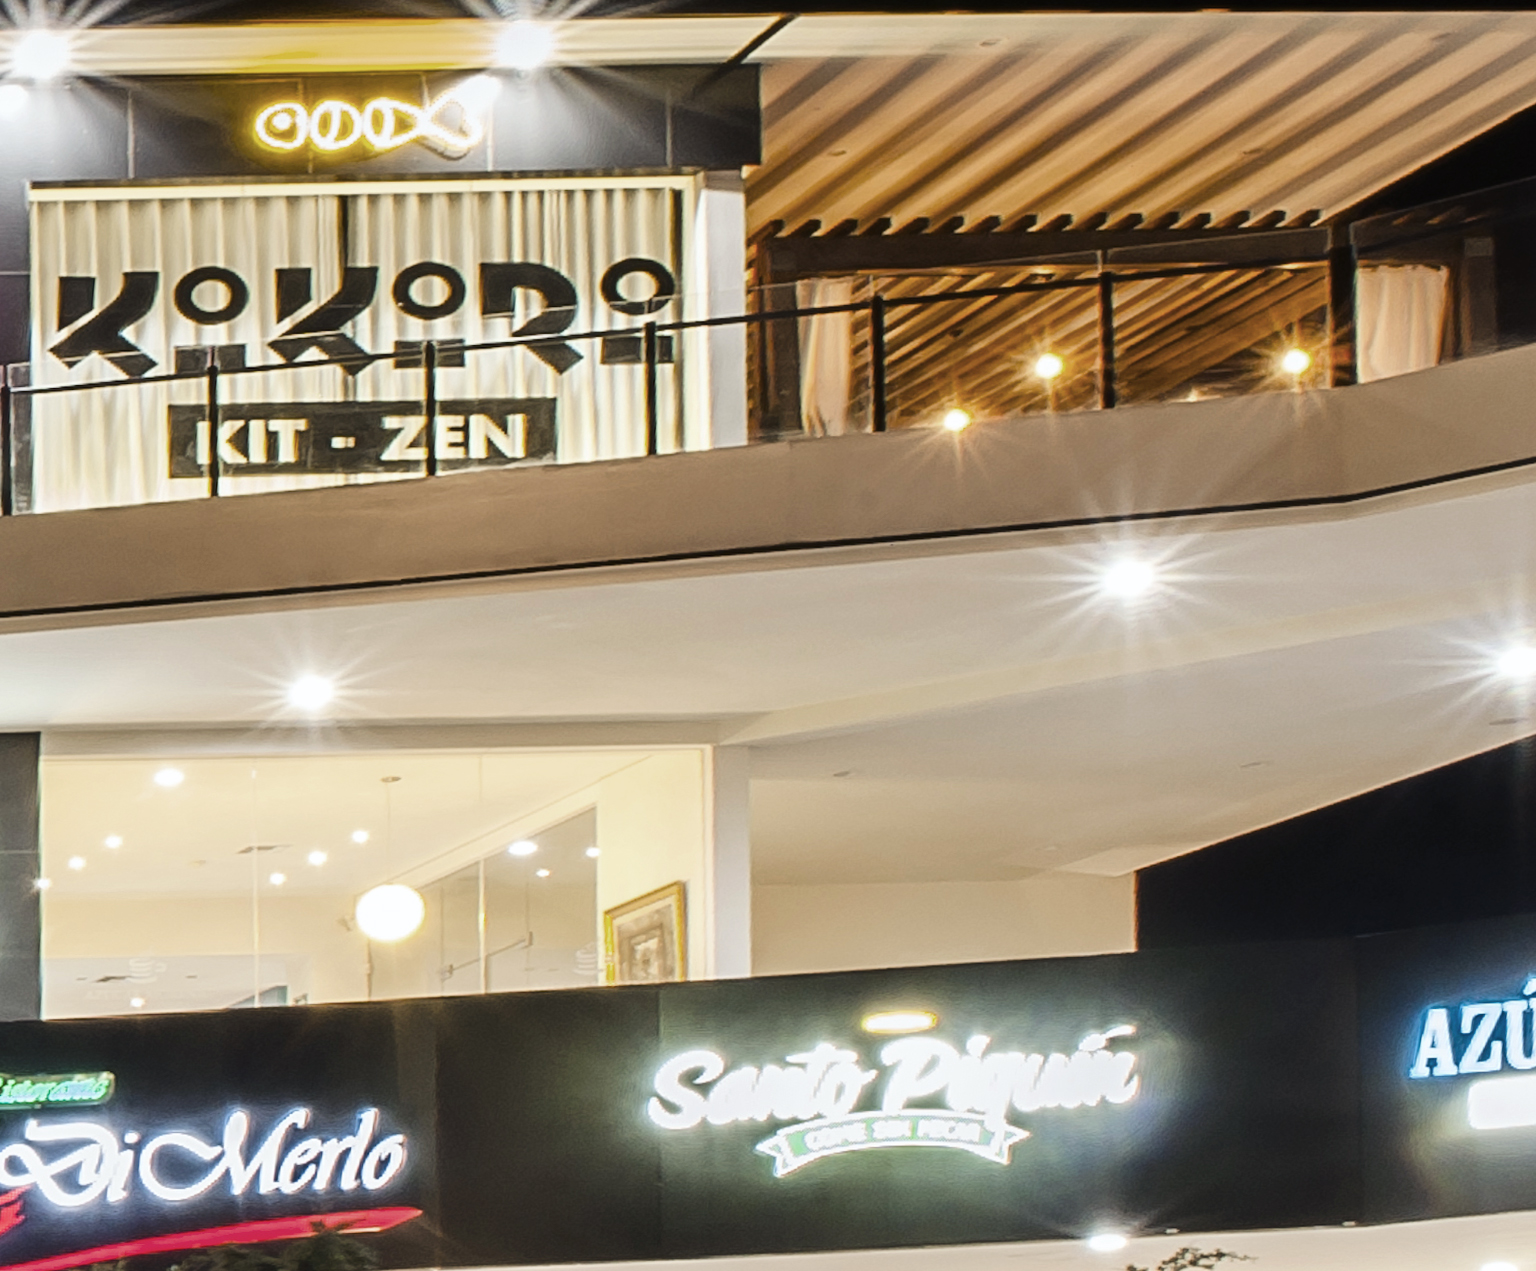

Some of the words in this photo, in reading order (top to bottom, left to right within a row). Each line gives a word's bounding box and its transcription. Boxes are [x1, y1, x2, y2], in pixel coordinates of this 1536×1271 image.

[196, 418, 308, 464] KIT
[379, 413, 527, 461] ZEN
[646, 1043, 879, 1131] Santo
[139, 1108, 408, 1202] Merlo
